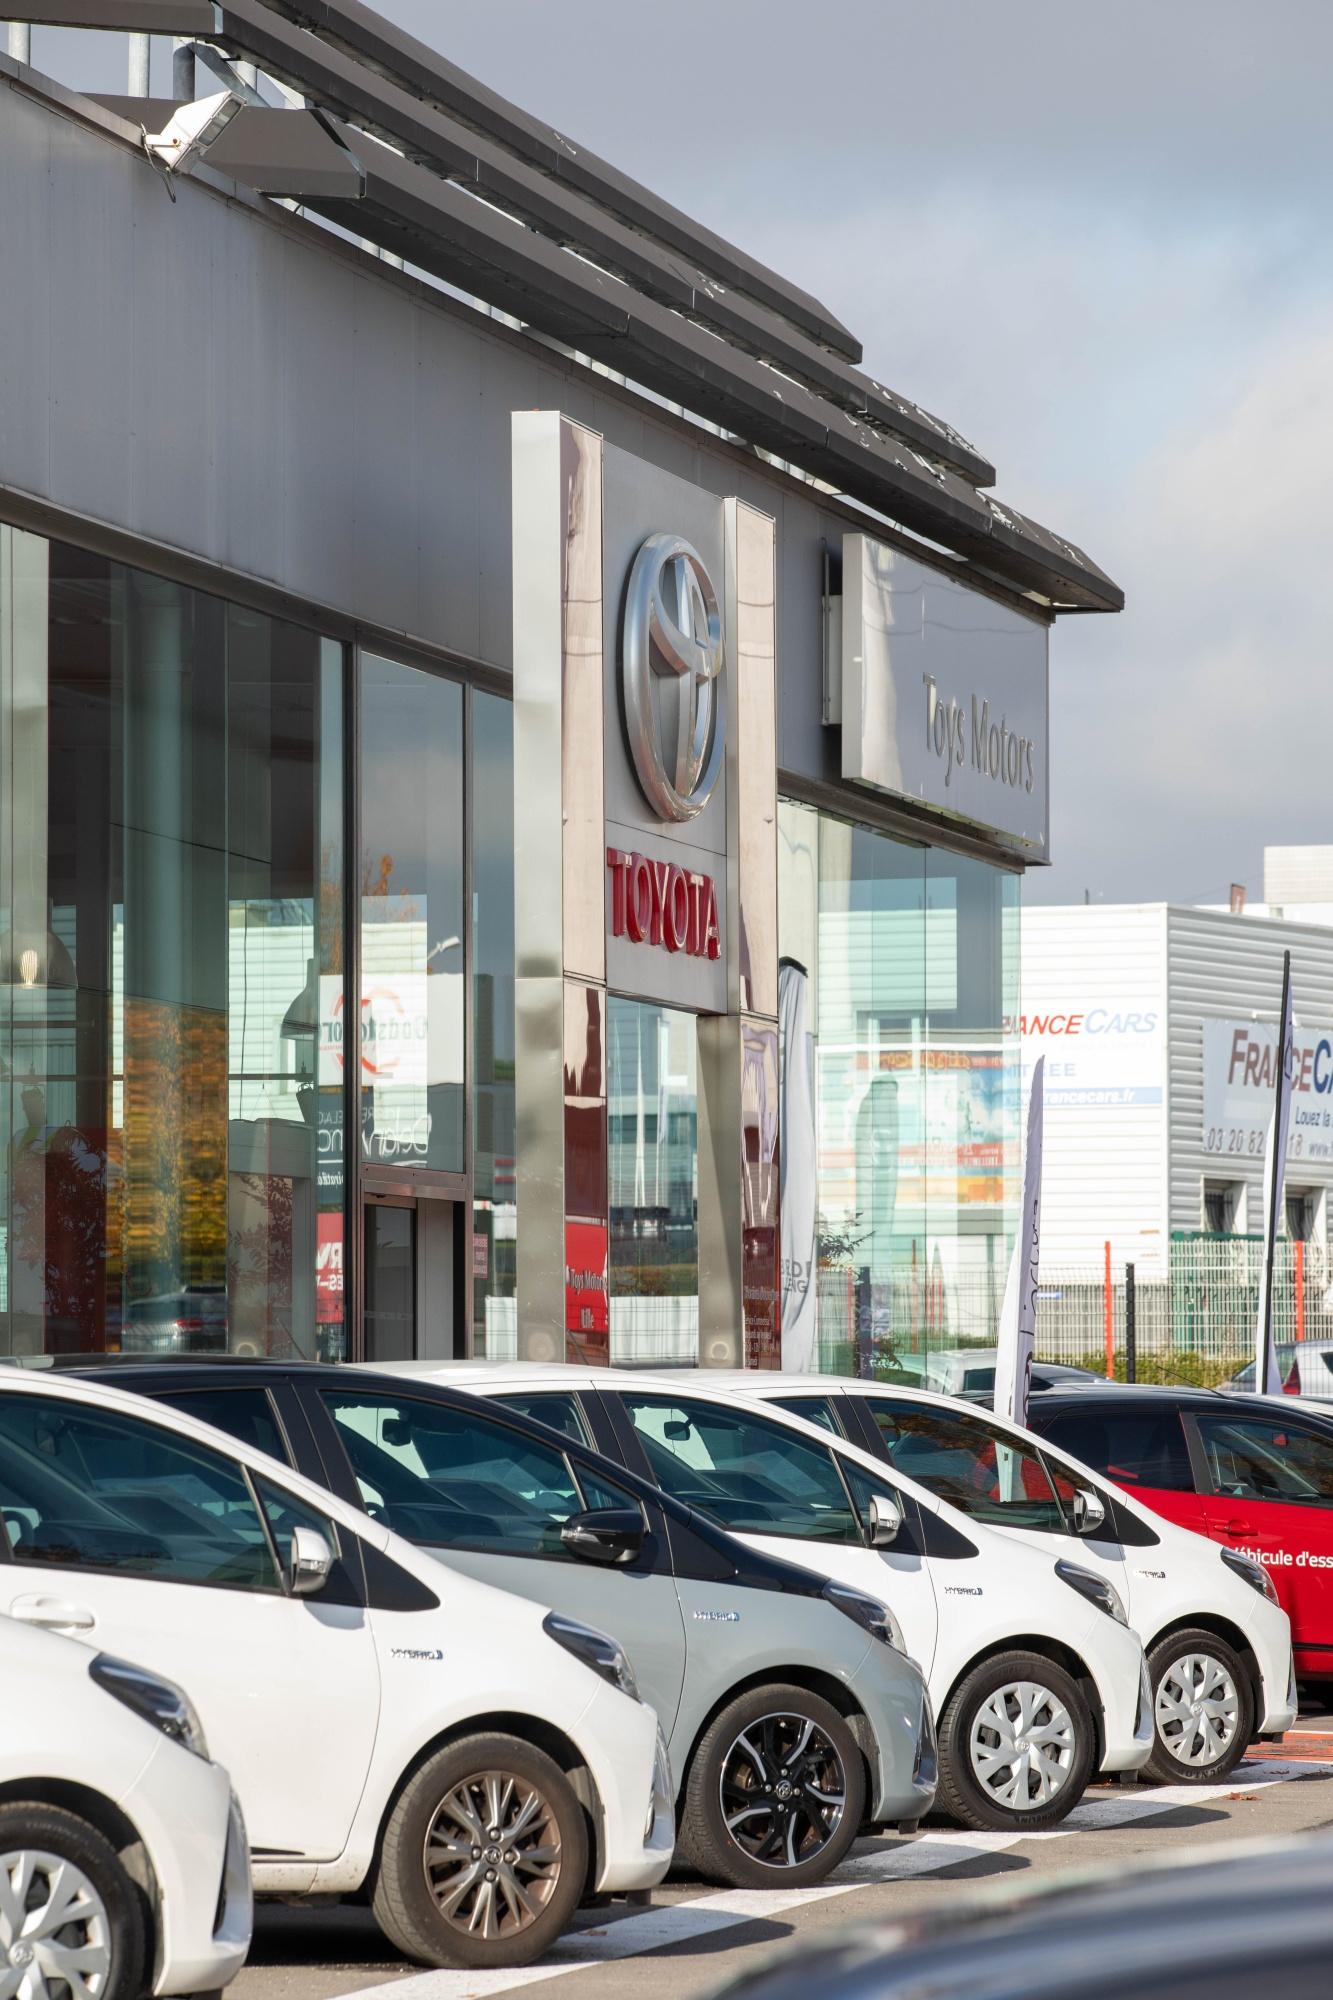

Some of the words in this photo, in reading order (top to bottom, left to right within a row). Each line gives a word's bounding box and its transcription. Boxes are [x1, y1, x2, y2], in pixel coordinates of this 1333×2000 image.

[922, 671, 965, 787] Toys
[971, 693, 1034, 794] Motors
[606, 846, 721, 961] TOYOTA
[1207, 1127, 1224, 1151] 03
[1228, 1128, 1244, 1152] 20
[1234, 1546, 1293, 1566] éhicule
